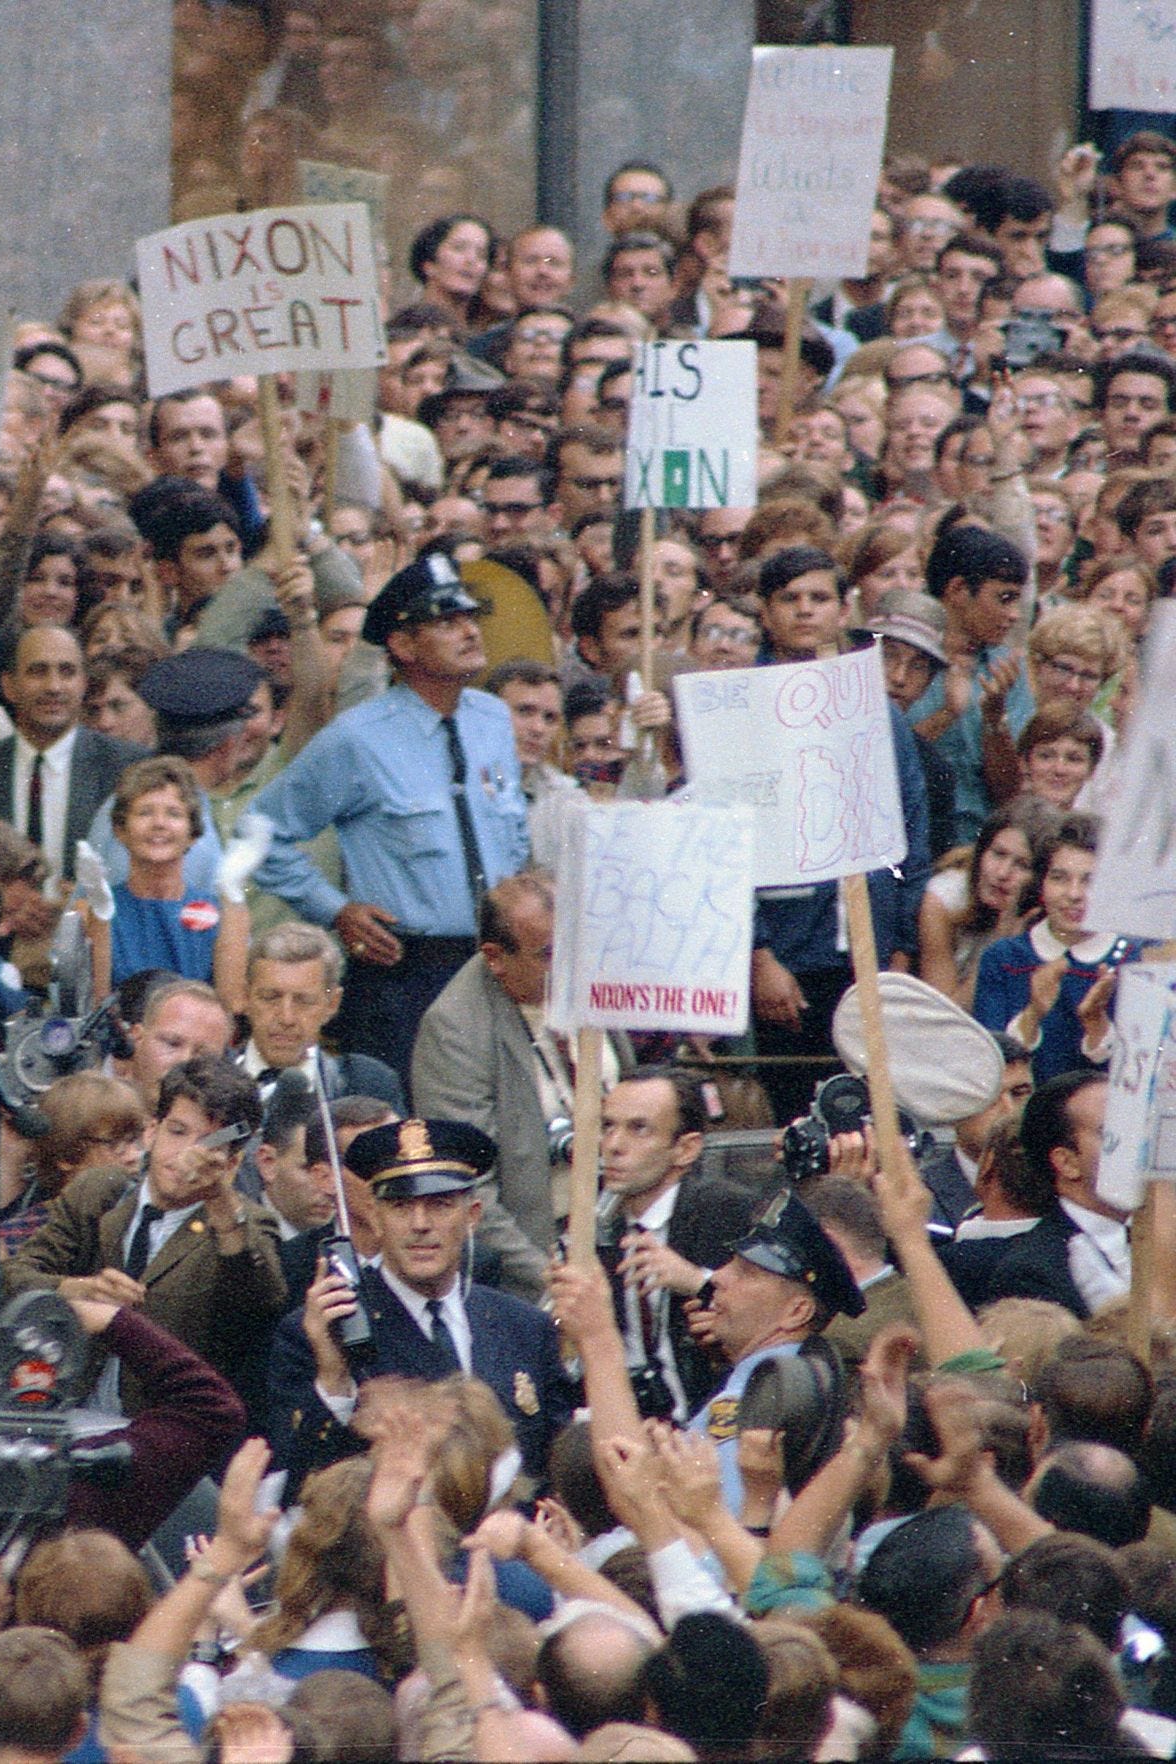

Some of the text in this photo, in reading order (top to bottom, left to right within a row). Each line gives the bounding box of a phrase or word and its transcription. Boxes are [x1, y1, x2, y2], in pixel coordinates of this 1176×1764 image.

[161, 218, 355, 293] NIXON
[171, 296, 386, 364] GREAT!
[692, 674, 751, 714] BE
[586, 864, 733, 926] BACK
[589, 981, 740, 1019] NIXON'S THE ONE!
